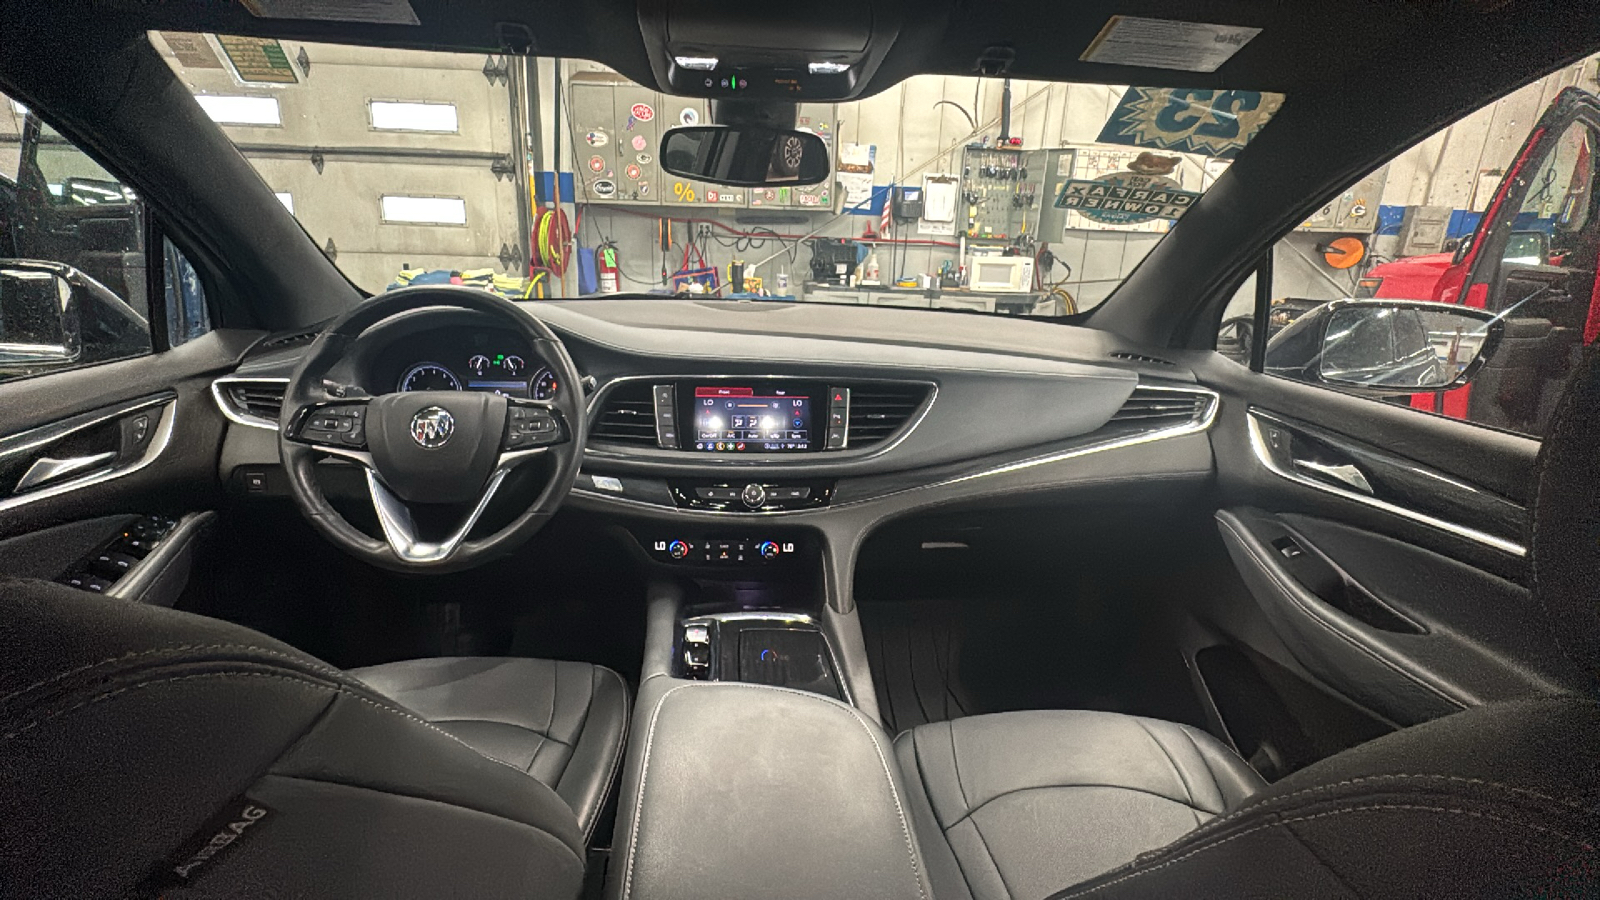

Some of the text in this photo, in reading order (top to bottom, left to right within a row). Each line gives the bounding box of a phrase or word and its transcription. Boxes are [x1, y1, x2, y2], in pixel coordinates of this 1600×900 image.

[654, 541, 666, 551] LO
[782, 543, 794, 553] LO
[173, 804, 268, 878] AIRBAG
